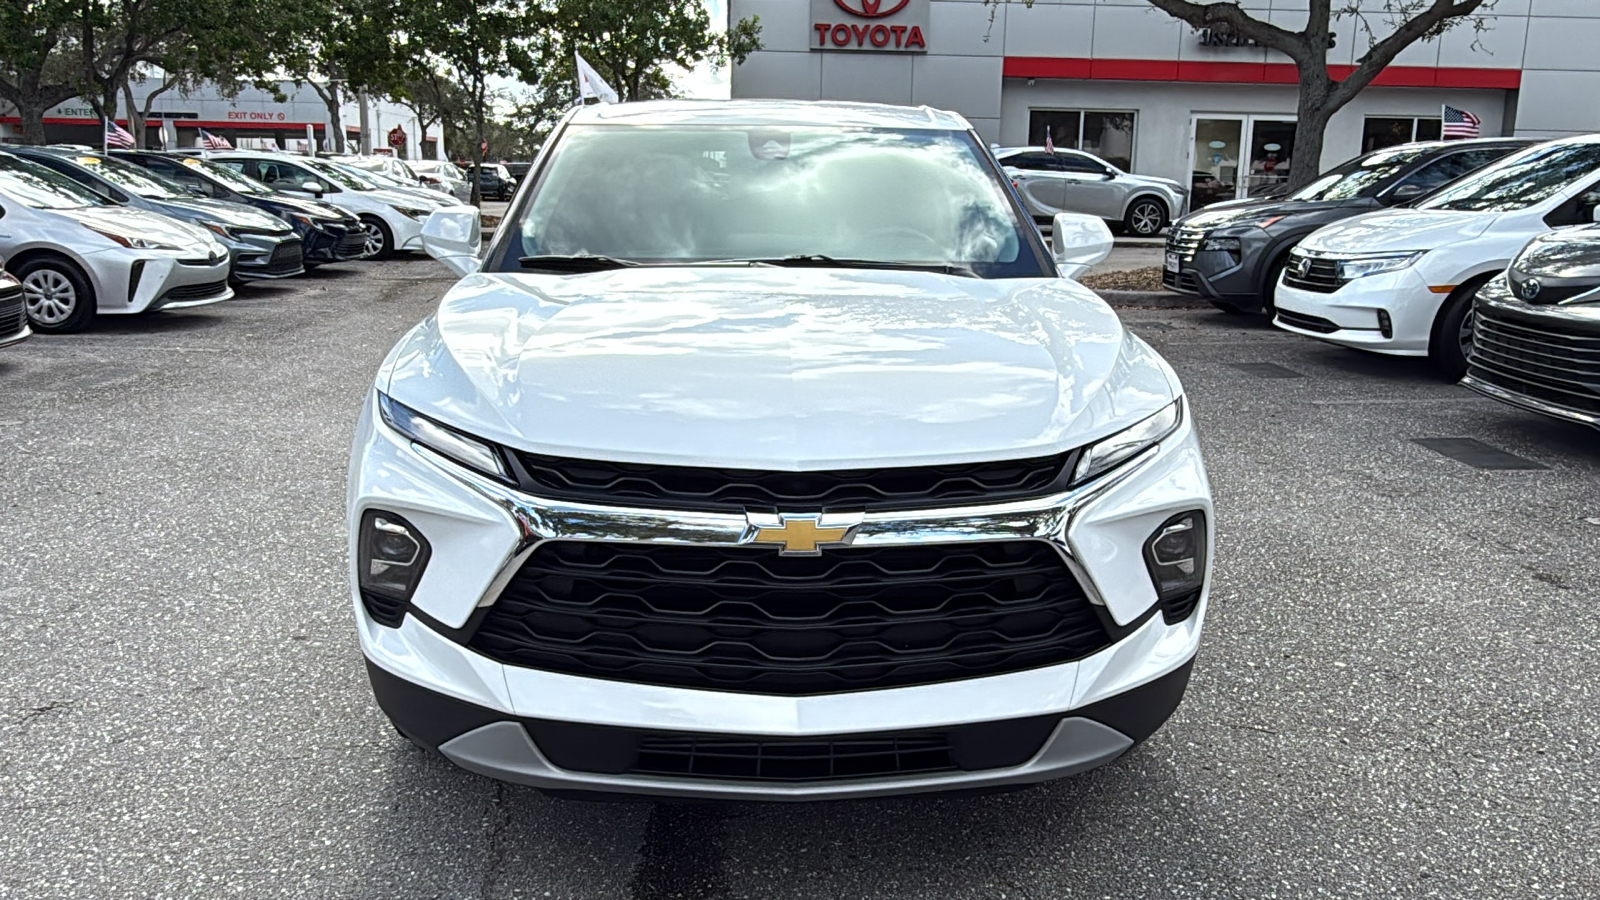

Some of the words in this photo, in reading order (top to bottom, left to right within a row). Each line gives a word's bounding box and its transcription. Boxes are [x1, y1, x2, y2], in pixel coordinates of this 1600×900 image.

[814, 23, 926, 48] TOYOTA
[228, 111, 248, 119] EXIT
[249, 112, 274, 120] ONLY
